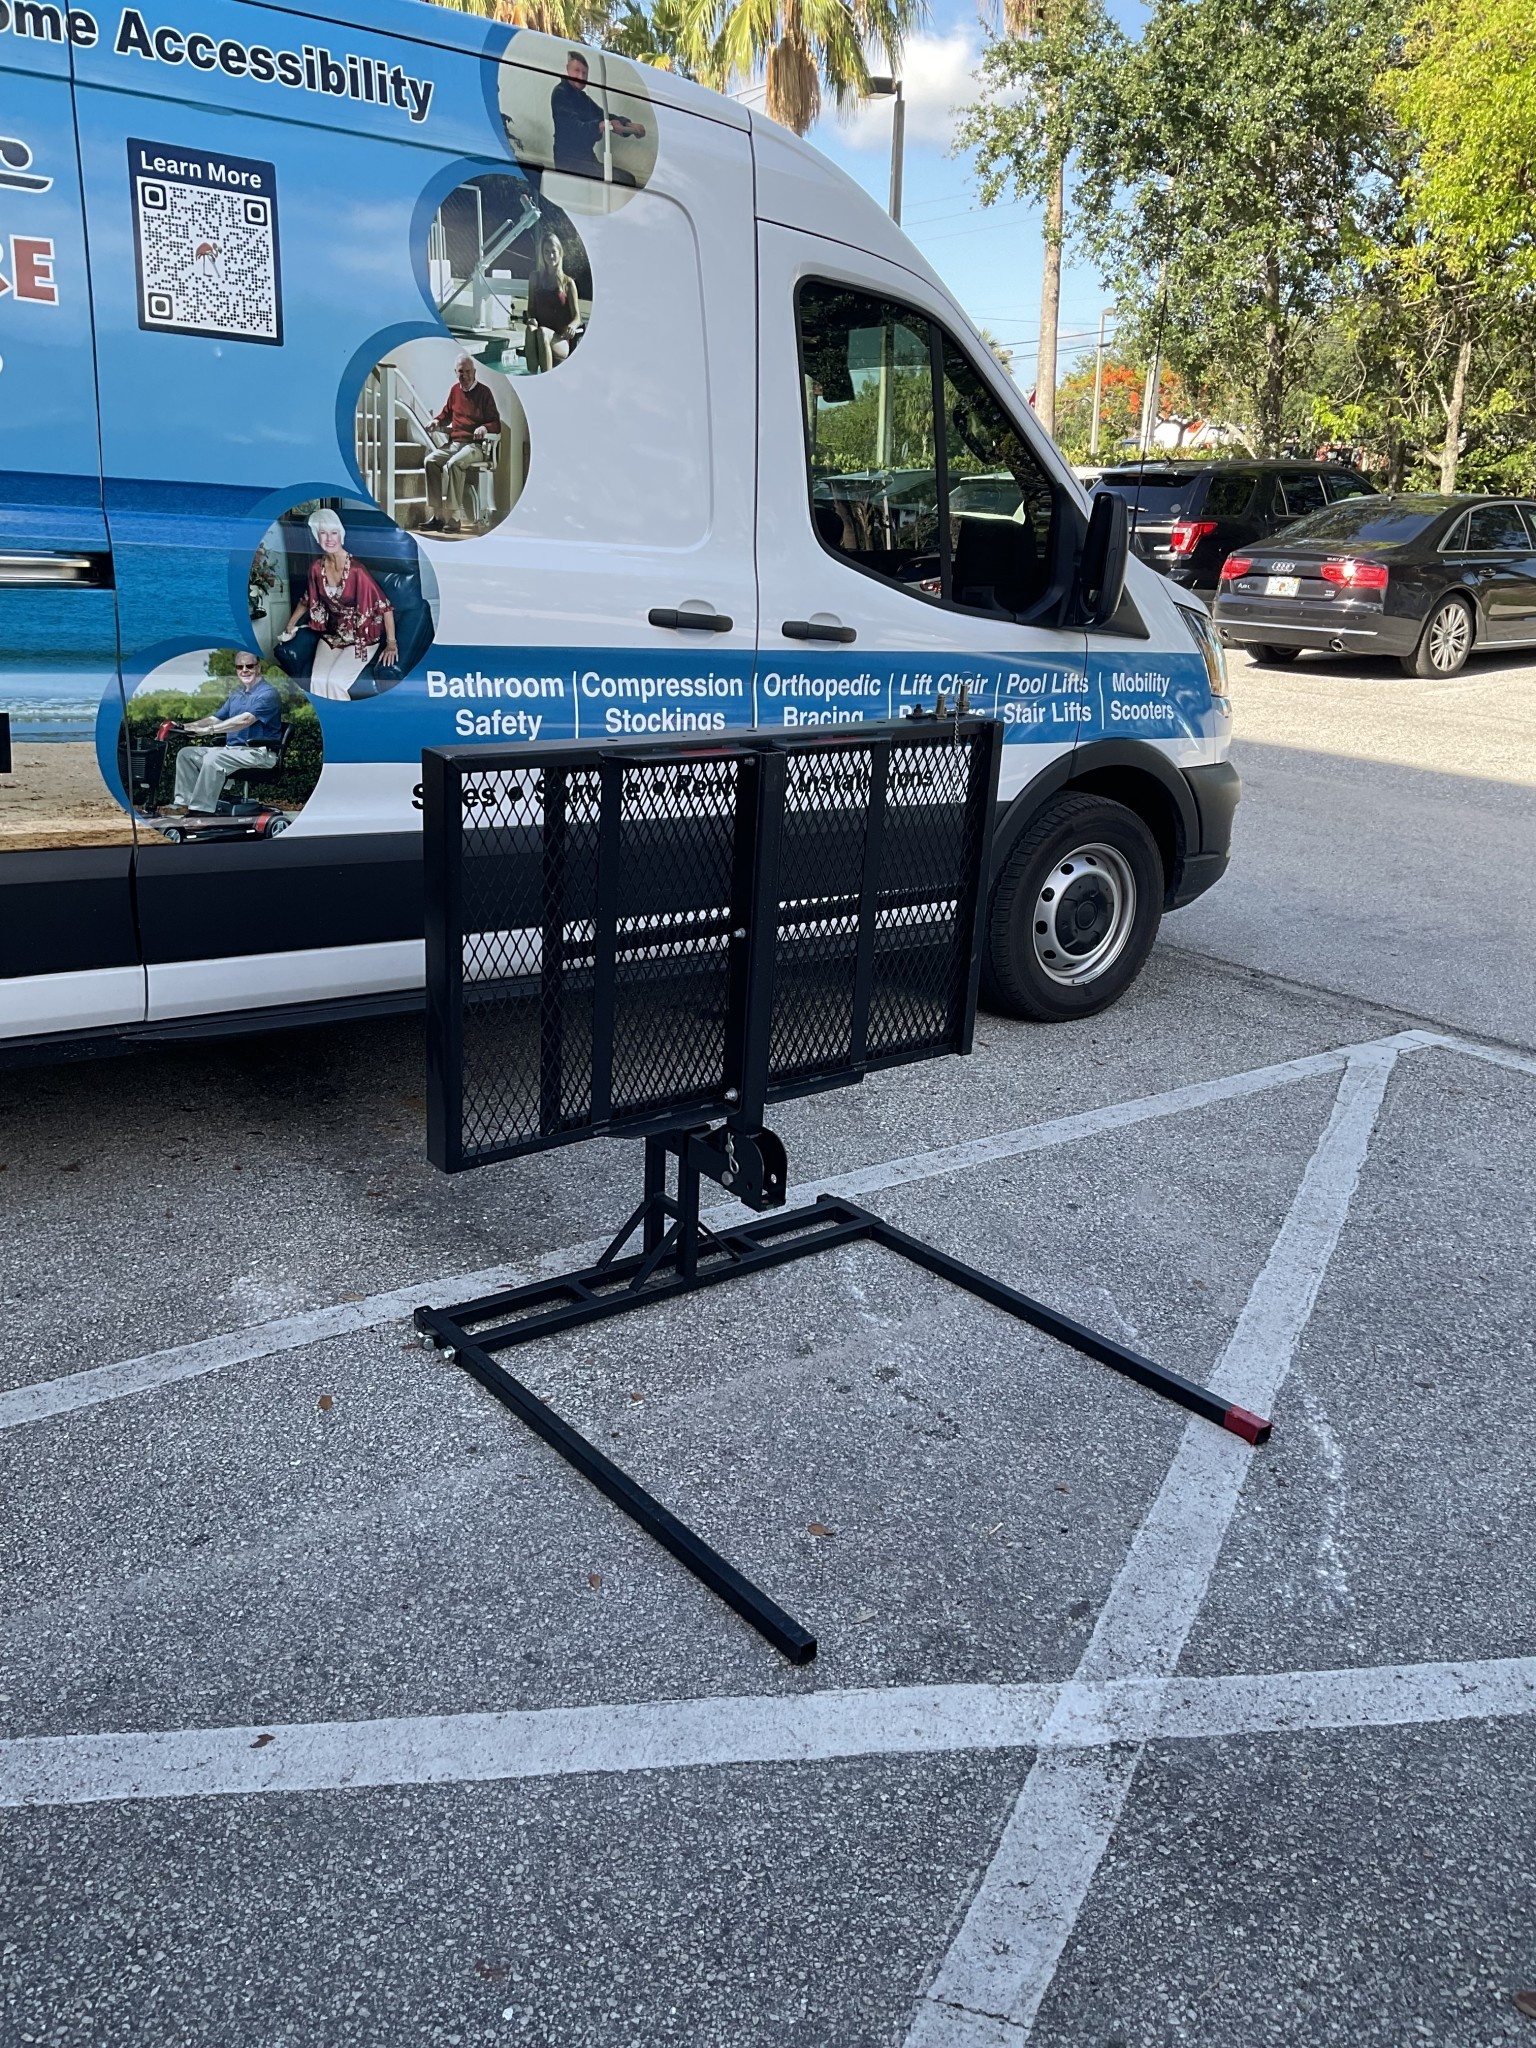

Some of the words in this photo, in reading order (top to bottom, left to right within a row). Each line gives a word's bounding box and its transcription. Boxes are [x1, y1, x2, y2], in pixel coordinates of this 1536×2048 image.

[0, 0, 98, 48] me
[114, 7, 434, 123] Accessibility
[141, 150, 201, 179] Learn
[207, 162, 262, 189] More
[0, 234, 59, 306] E
[426, 670, 565, 698] Bathroom
[581, 671, 743, 703] Compression
[763, 672, 882, 702] Orthopedic
[900, 673, 933, 695] Lift
[1006, 673, 1047, 694] Pool
[1051, 672, 1089, 694] Lifts
[1112, 672, 1171, 698] Mobility
[455, 709, 543, 741] Safety
[1003, 702, 1046, 724] Stair
[1051, 701, 1092, 722] Lifts
[1110, 700, 1175, 721] Scooters
